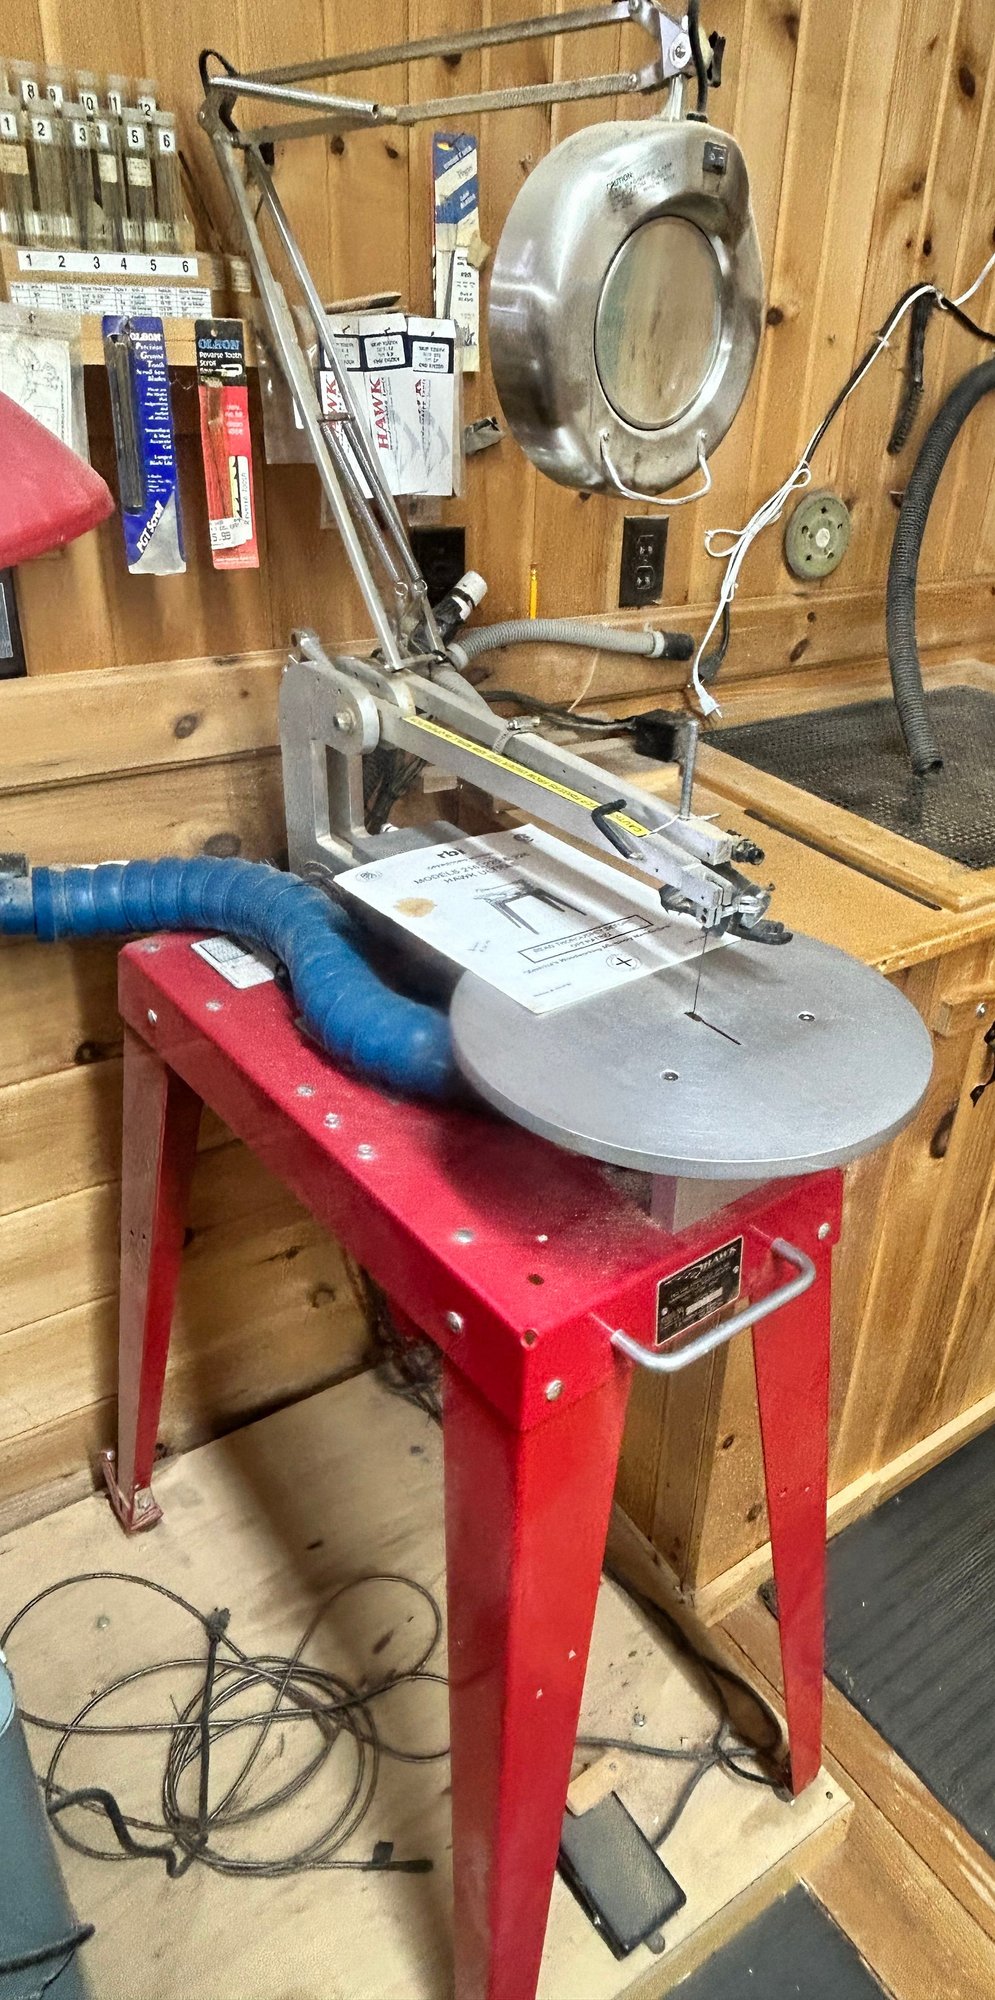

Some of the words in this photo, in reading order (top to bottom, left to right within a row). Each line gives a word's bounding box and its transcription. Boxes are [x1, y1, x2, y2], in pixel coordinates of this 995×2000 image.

[27, 84, 35, 99] 8
[50, 88, 56, 102] 9
[81, 95, 94, 111] 10
[139, 103, 151, 117] 12
[4, 117, 10, 131] 1
[37, 122, 45, 137] 2
[79, 127, 87, 142] 3
[163, 134, 171, 148] 6
[26, 254, 32, 266] 1
[58, 255, 66, 268] 2
[93, 256, 101, 269] 3
[120, 257, 128, 270] 4
[150, 259, 157, 271] 5
[182, 260, 189, 273] 6
[130, 332, 162, 341] OLSON
[198, 338, 240, 350] OLSON
[199, 351, 223, 359] Reverse
[369, 374, 390, 449] HAWK
